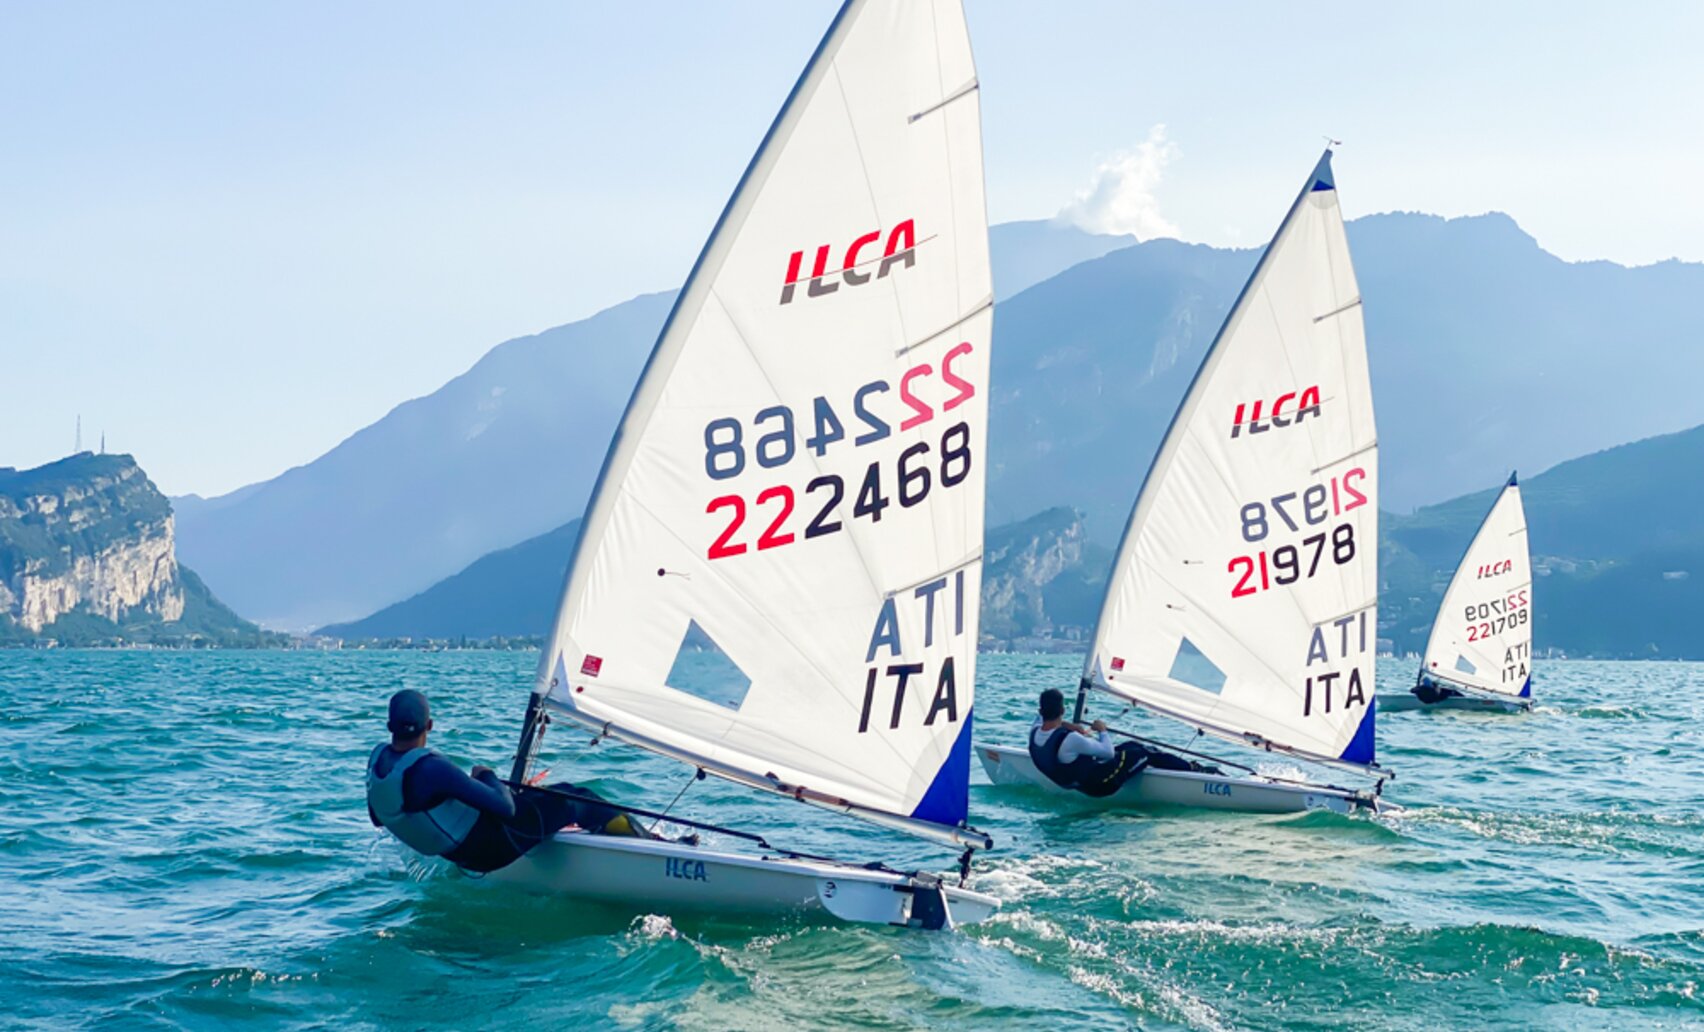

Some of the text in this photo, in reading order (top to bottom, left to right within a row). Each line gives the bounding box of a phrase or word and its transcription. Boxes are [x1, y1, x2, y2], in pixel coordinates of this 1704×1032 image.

[780, 219, 916, 305] ILCA
[1231, 386, 1322, 438] ILCA
[706, 422, 972, 560] 222468
[1228, 523, 1356, 598] 21978
[1477, 559, 1512, 578] ILCA
[1466, 609, 1528, 641] 221709
[858, 656, 957, 733] ITA
[1303, 667, 1366, 717] ITA
[1502, 662, 1527, 683] ITA
[1203, 782, 1232, 797] ILCA
[665, 857, 707, 881] ILCA
